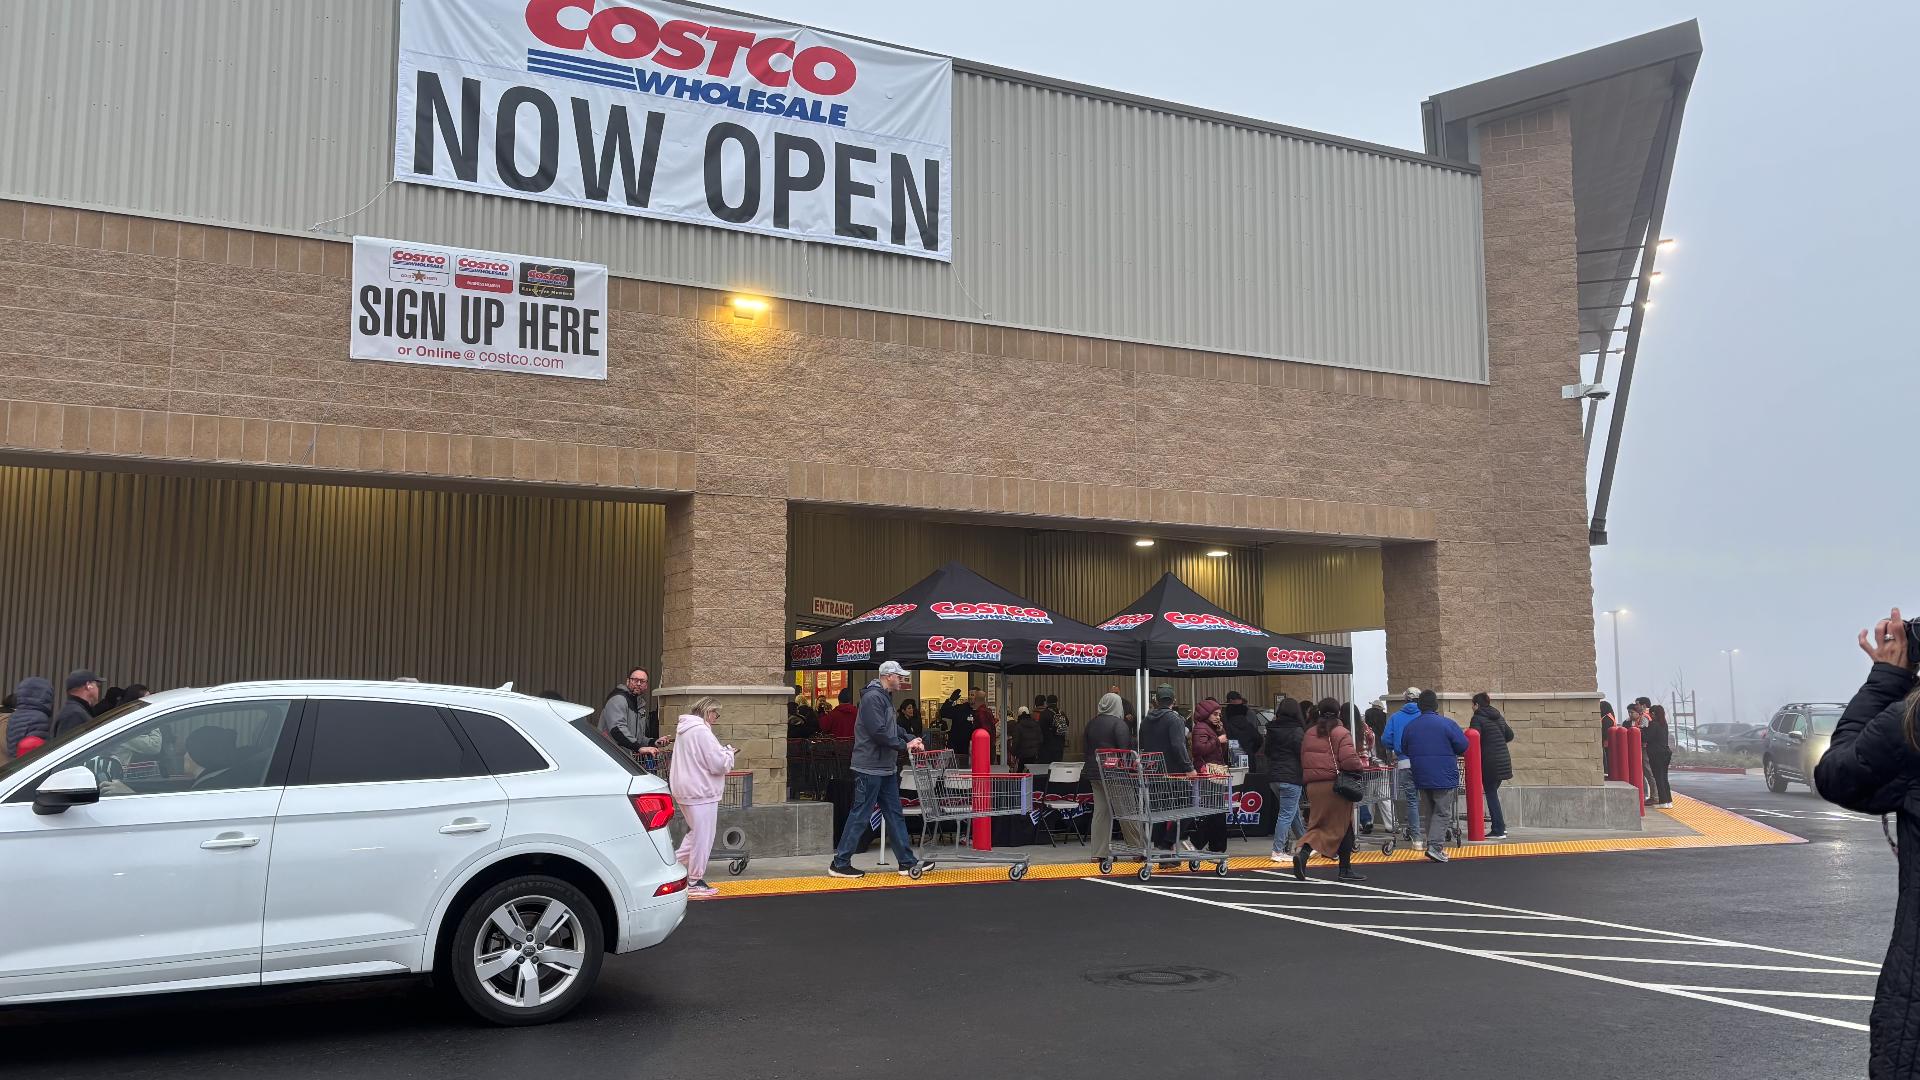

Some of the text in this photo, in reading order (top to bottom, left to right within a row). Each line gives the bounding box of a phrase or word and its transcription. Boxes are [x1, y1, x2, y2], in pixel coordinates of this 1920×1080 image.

[524, 0, 857, 95] COSTCO
[634, 68, 849, 127] WHOLESALE
[413, 70, 941, 252] NOW OPEN
[392, 251, 446, 264] COSTCO
[458, 258, 510, 271] COSTCO
[359, 284, 600, 357] SIGN UP HERE
[397, 346, 564, 369] or Online @ costco.com
[814, 599, 853, 618] ENTRANCE
[930, 602, 1048, 618] COSTCO
[927, 636, 1004, 654] COSTCO
[1037, 639, 1108, 658] COSTCO
[1177, 643, 1239, 661] COSTCO
[951, 653, 1001, 661] WHOLESALE
[1060, 656, 1105, 664] WHOLESALE
[1267, 646, 1325, 663] COSTCO
